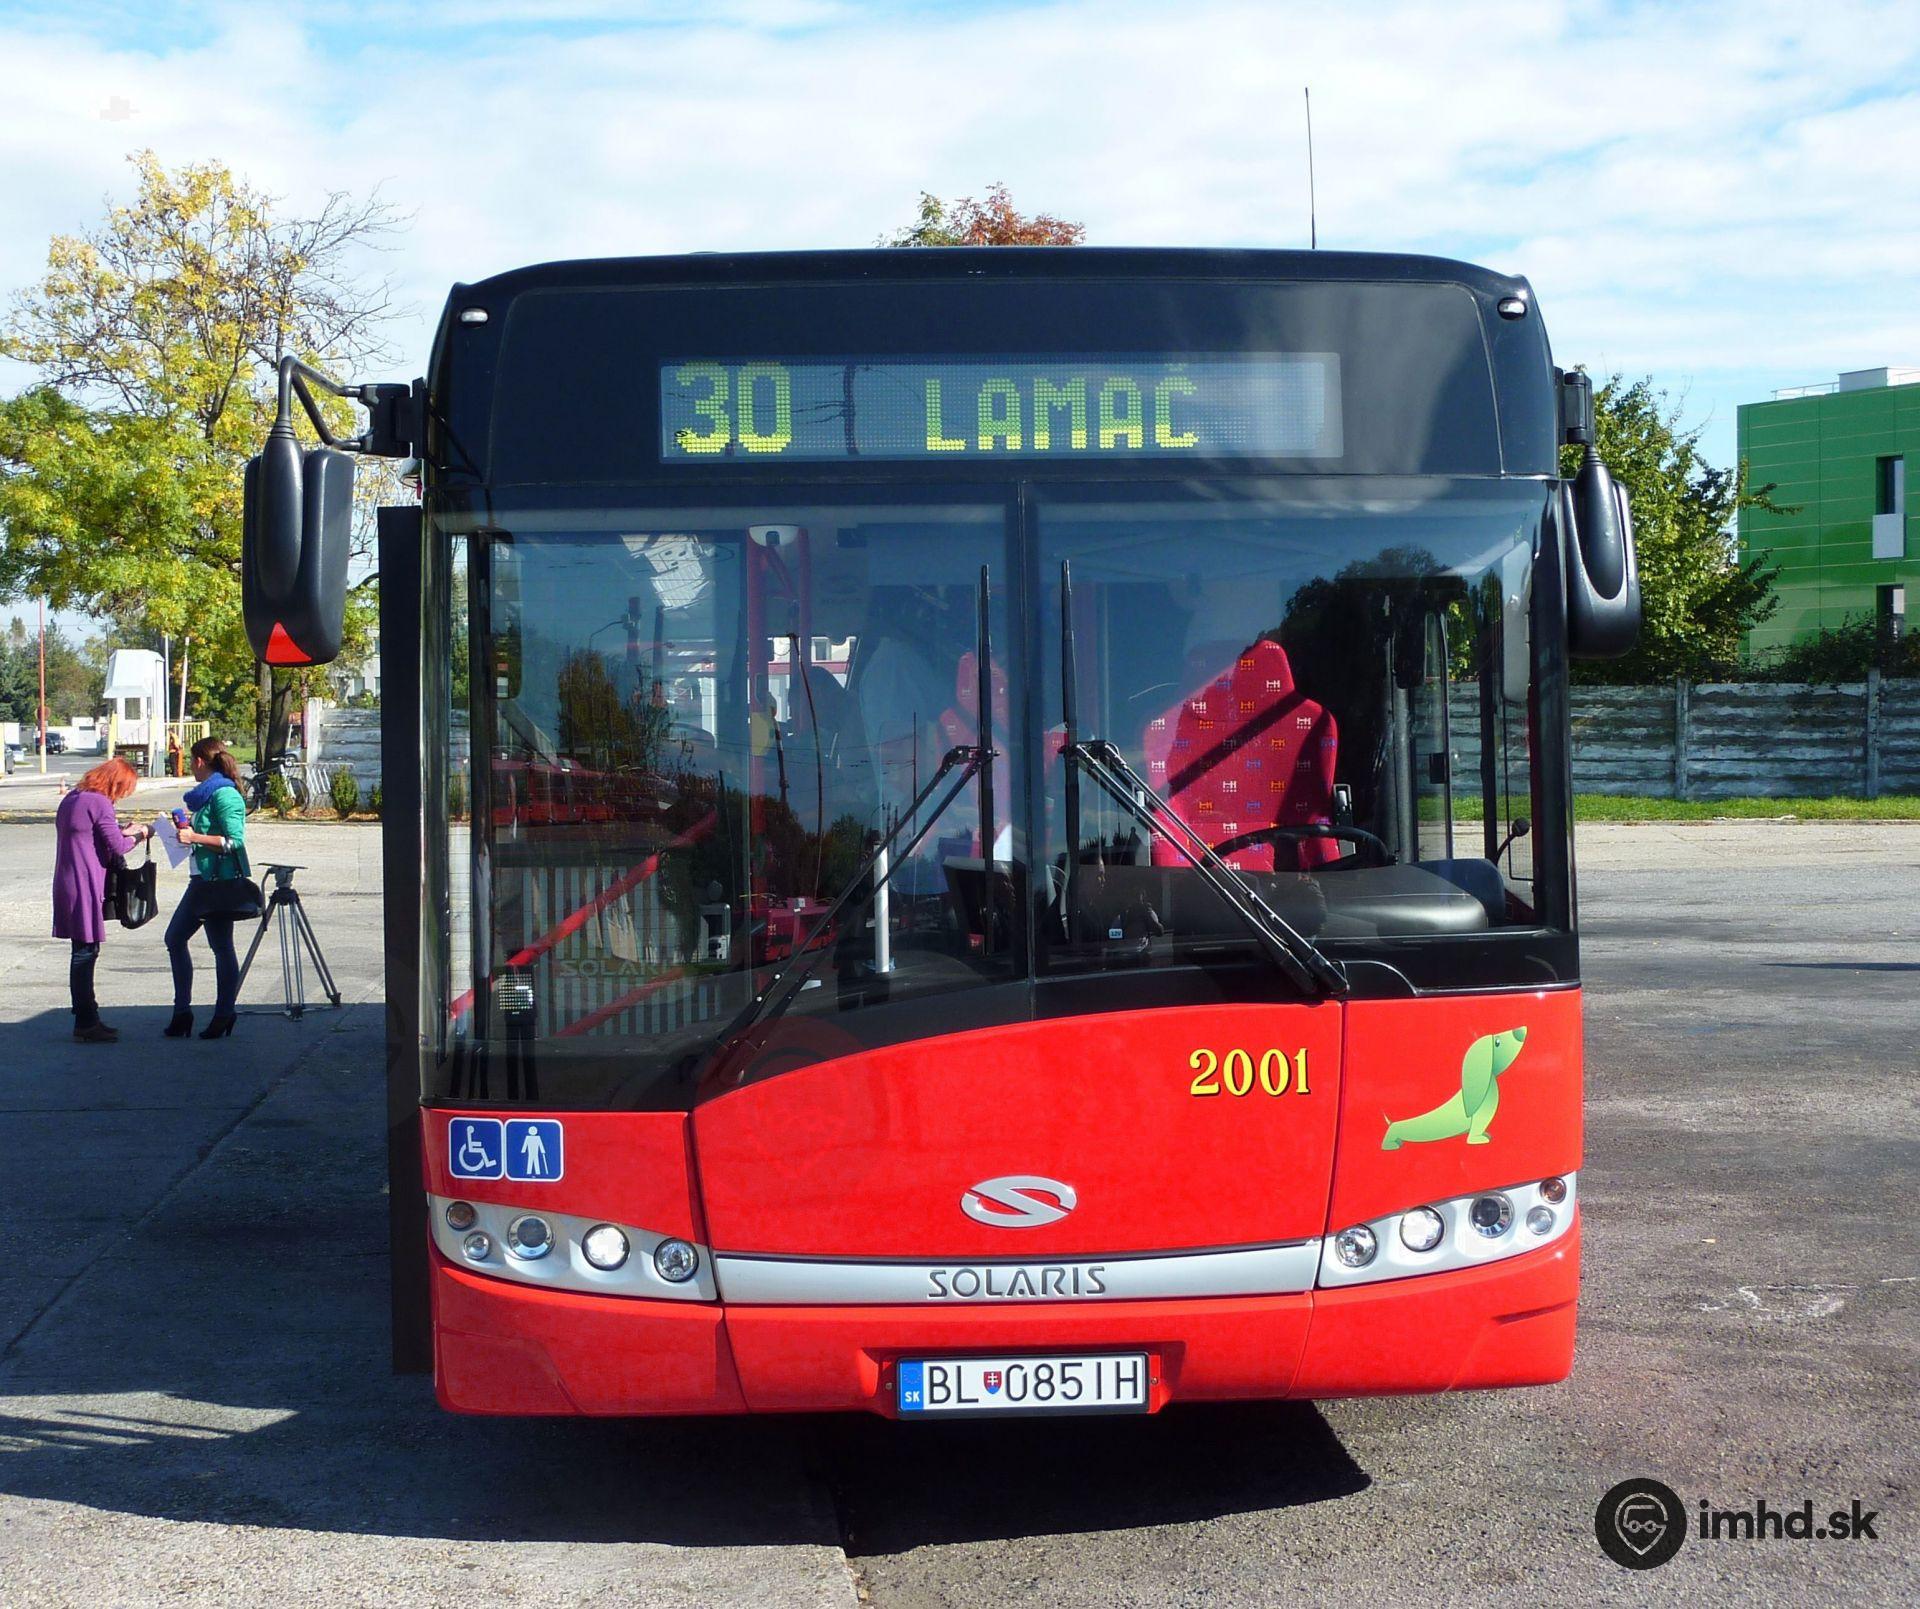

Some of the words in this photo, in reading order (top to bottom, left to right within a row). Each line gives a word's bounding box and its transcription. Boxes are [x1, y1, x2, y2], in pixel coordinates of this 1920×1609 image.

[675, 361, 791, 453] 30
[1189, 1047, 1311, 1097] 2001
[928, 1265, 1106, 1298] SOLARIS
[904, 1391, 920, 1402] SK
[928, 1365, 979, 1404] BL
